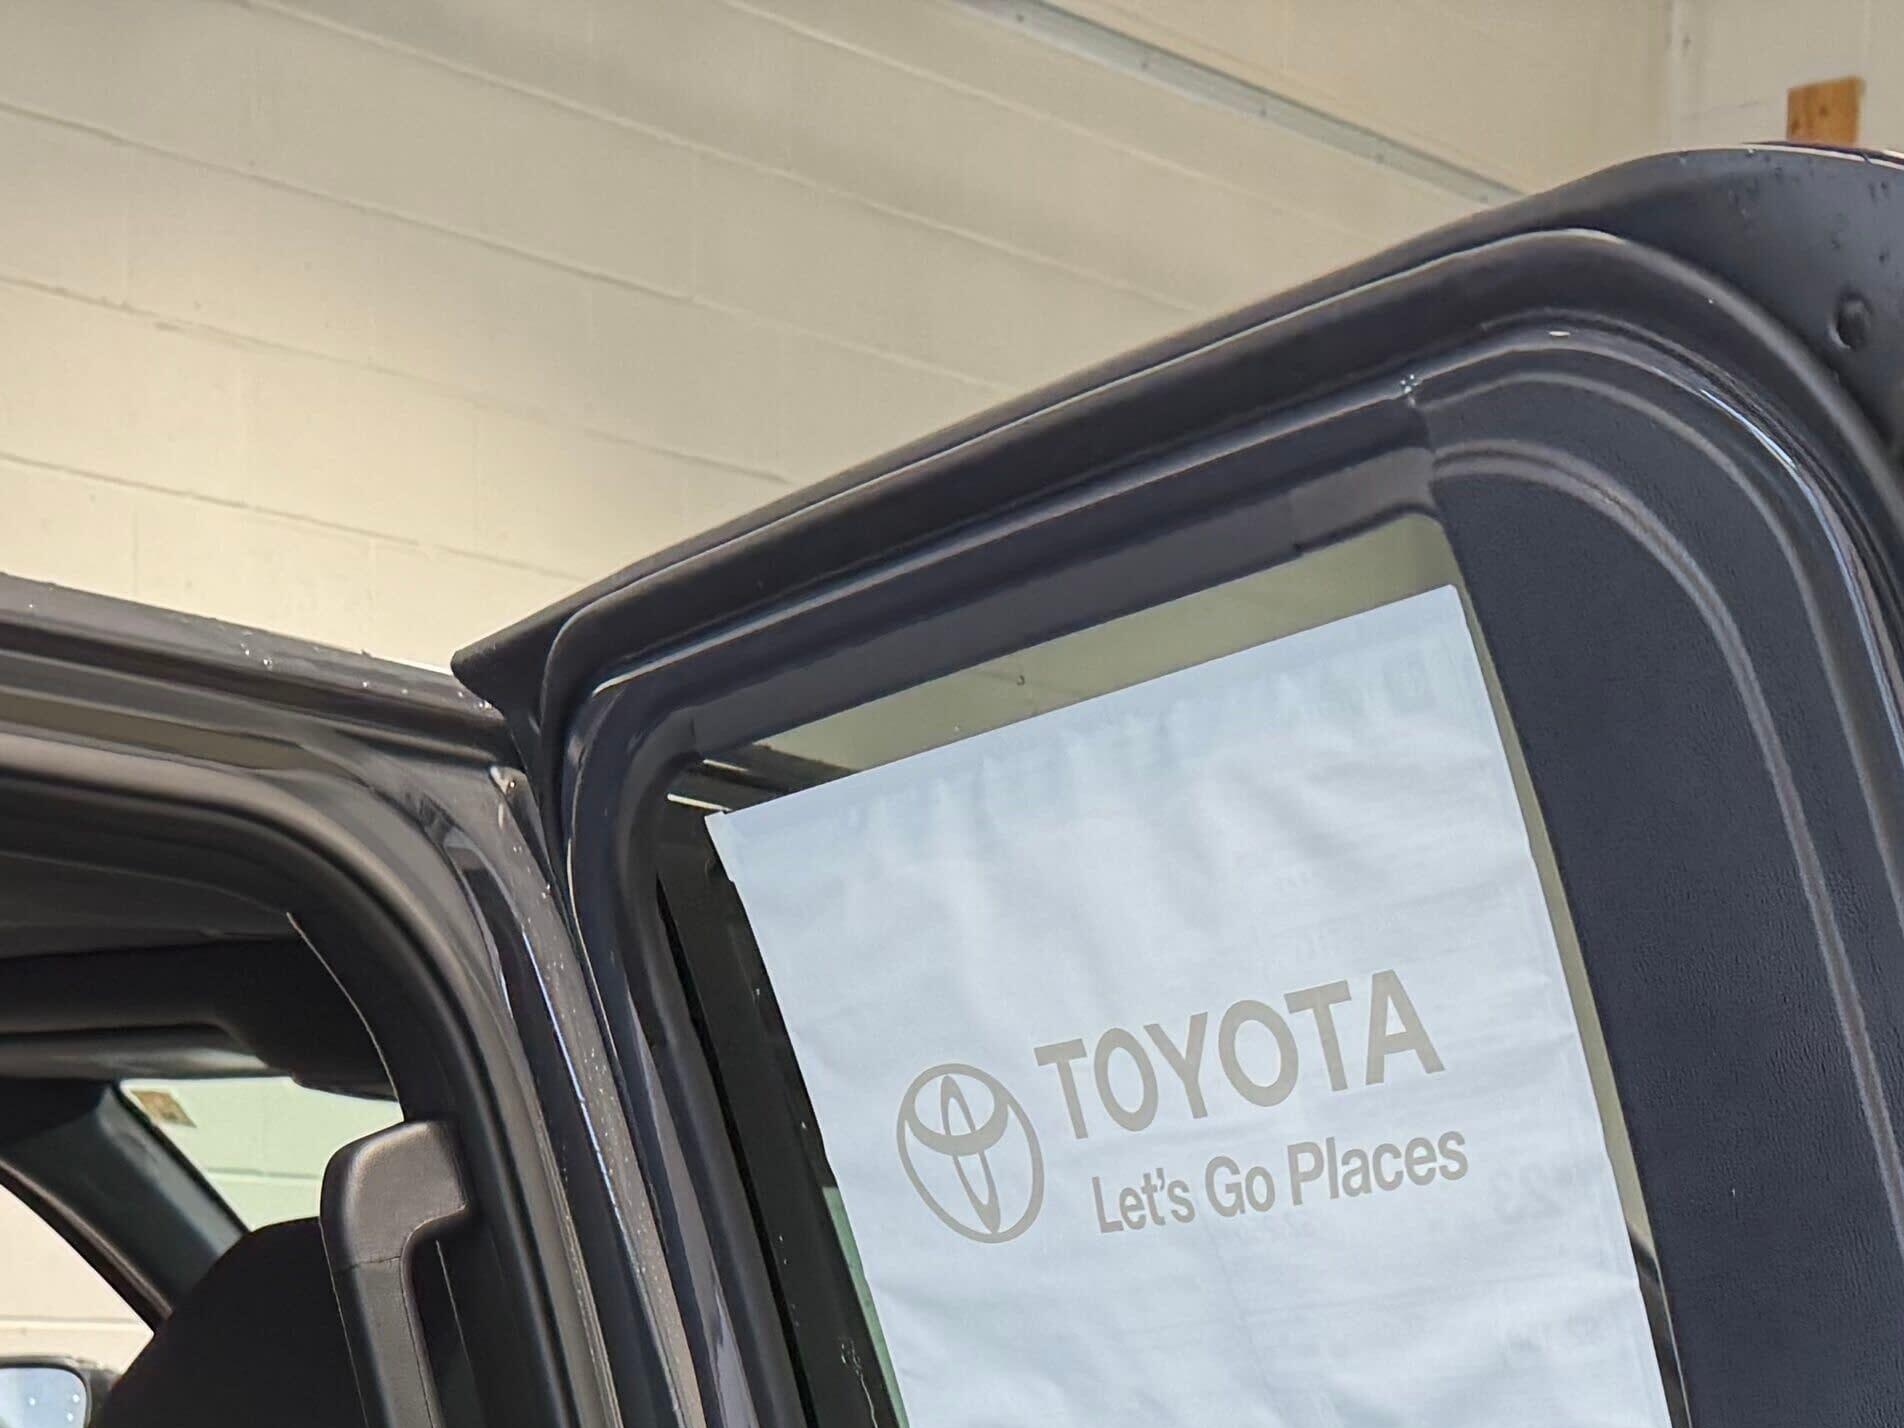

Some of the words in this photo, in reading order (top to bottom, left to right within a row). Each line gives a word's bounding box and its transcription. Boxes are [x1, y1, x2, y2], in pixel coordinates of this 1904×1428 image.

[1033, 969, 1444, 1140] TOYOTA
[1091, 1167, 1196, 1234] Let's
[1204, 1155, 1276, 1217] Go
[1286, 1131, 1469, 1207] Places
